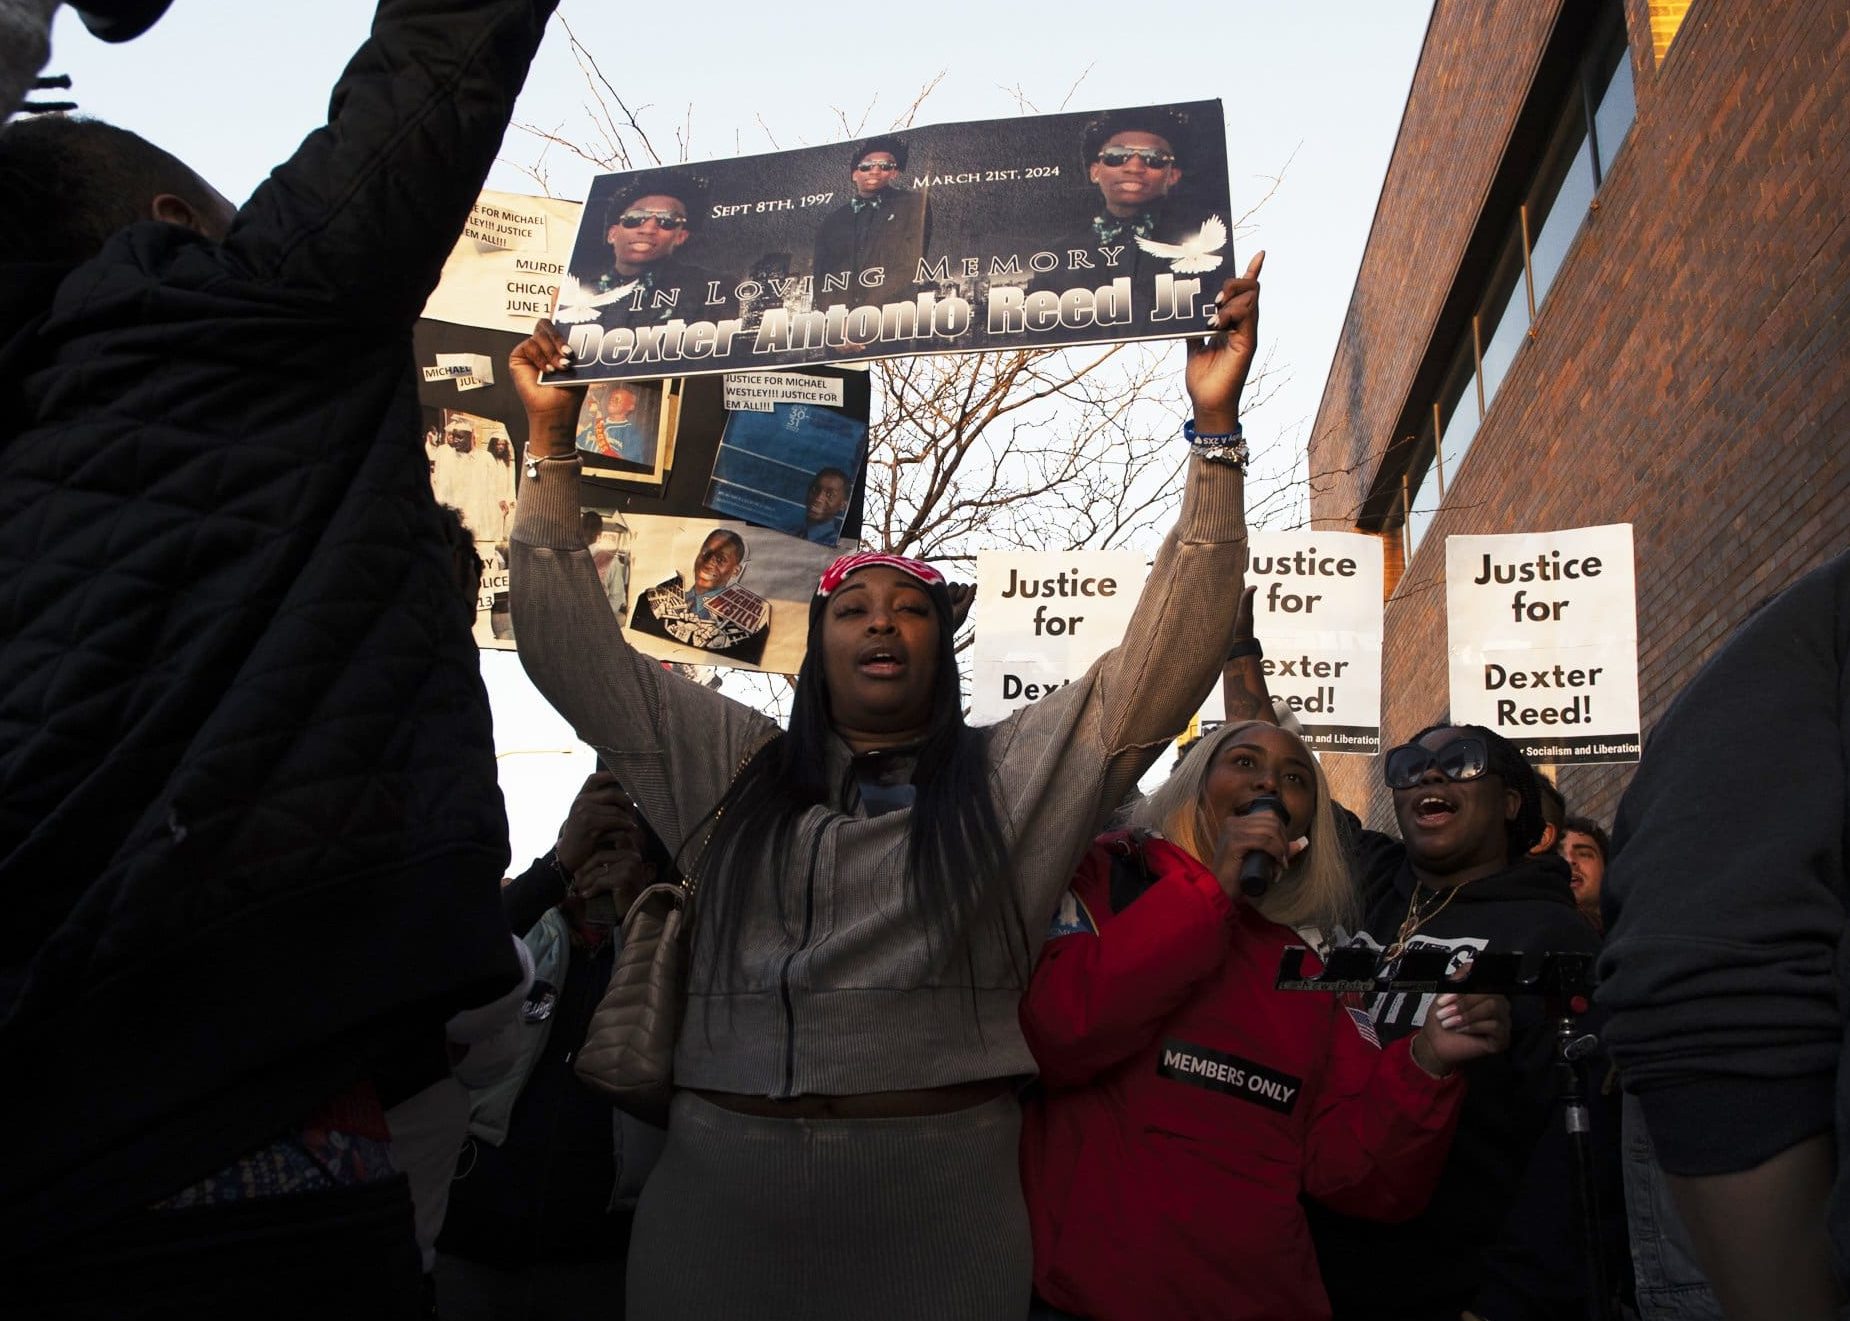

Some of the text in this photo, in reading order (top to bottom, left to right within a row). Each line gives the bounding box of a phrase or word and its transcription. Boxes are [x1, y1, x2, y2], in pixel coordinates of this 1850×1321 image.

[913, 173, 980, 189] MARCH
[1025, 166, 1060, 179] 2024
[481, 206, 500, 219] FOR
[501, 211, 545, 225] MICHAEL
[711, 204, 752, 219] SEPT
[800, 192, 834, 208] 1997
[465, 228, 507, 248] EM ALL!!!
[469, 216, 533, 238] LEY!!! JUSTICE
[515, 259, 565, 275] MURDE
[629, 245, 1125, 312] IN LOVING MEMORY
[506, 281, 557, 297] CHICAG
[506, 300, 552, 314] JUNE 1
[568, 273, 1219, 368] Dexter Antonio Reed Jr.
[425, 366, 473, 378] MICHAEL
[726, 374, 828, 389] JUSTICE FOR MICHAEL
[725, 387, 838, 402] WESTLEY!!! JUSTICE FOR
[726, 400, 770, 411] EM ALL!!!
[1474, 550, 1602, 585] Justice
[480, 576, 509, 589] LICE
[1001, 567, 1118, 599] Justice
[1267, 582, 1323, 613] for
[1511, 590, 1569, 622] for
[1033, 605, 1085, 636] for
[1260, 655, 1349, 678] exter
[1484, 664, 1603, 690] Dexter
[1003, 674, 1070, 700] Dex
[1269, 686, 1335, 713] ed!
[1497, 695, 1592, 726] Reed!
[1315, 734, 1332, 743] and
[1334, 734, 1379, 745] Liberation
[1526, 745, 1572, 756] Socialism
[1574, 745, 1591, 755] and
[1593, 743, 1640, 754] Liberation
[1163, 1049, 1296, 1103] MEMBERS ONLY
